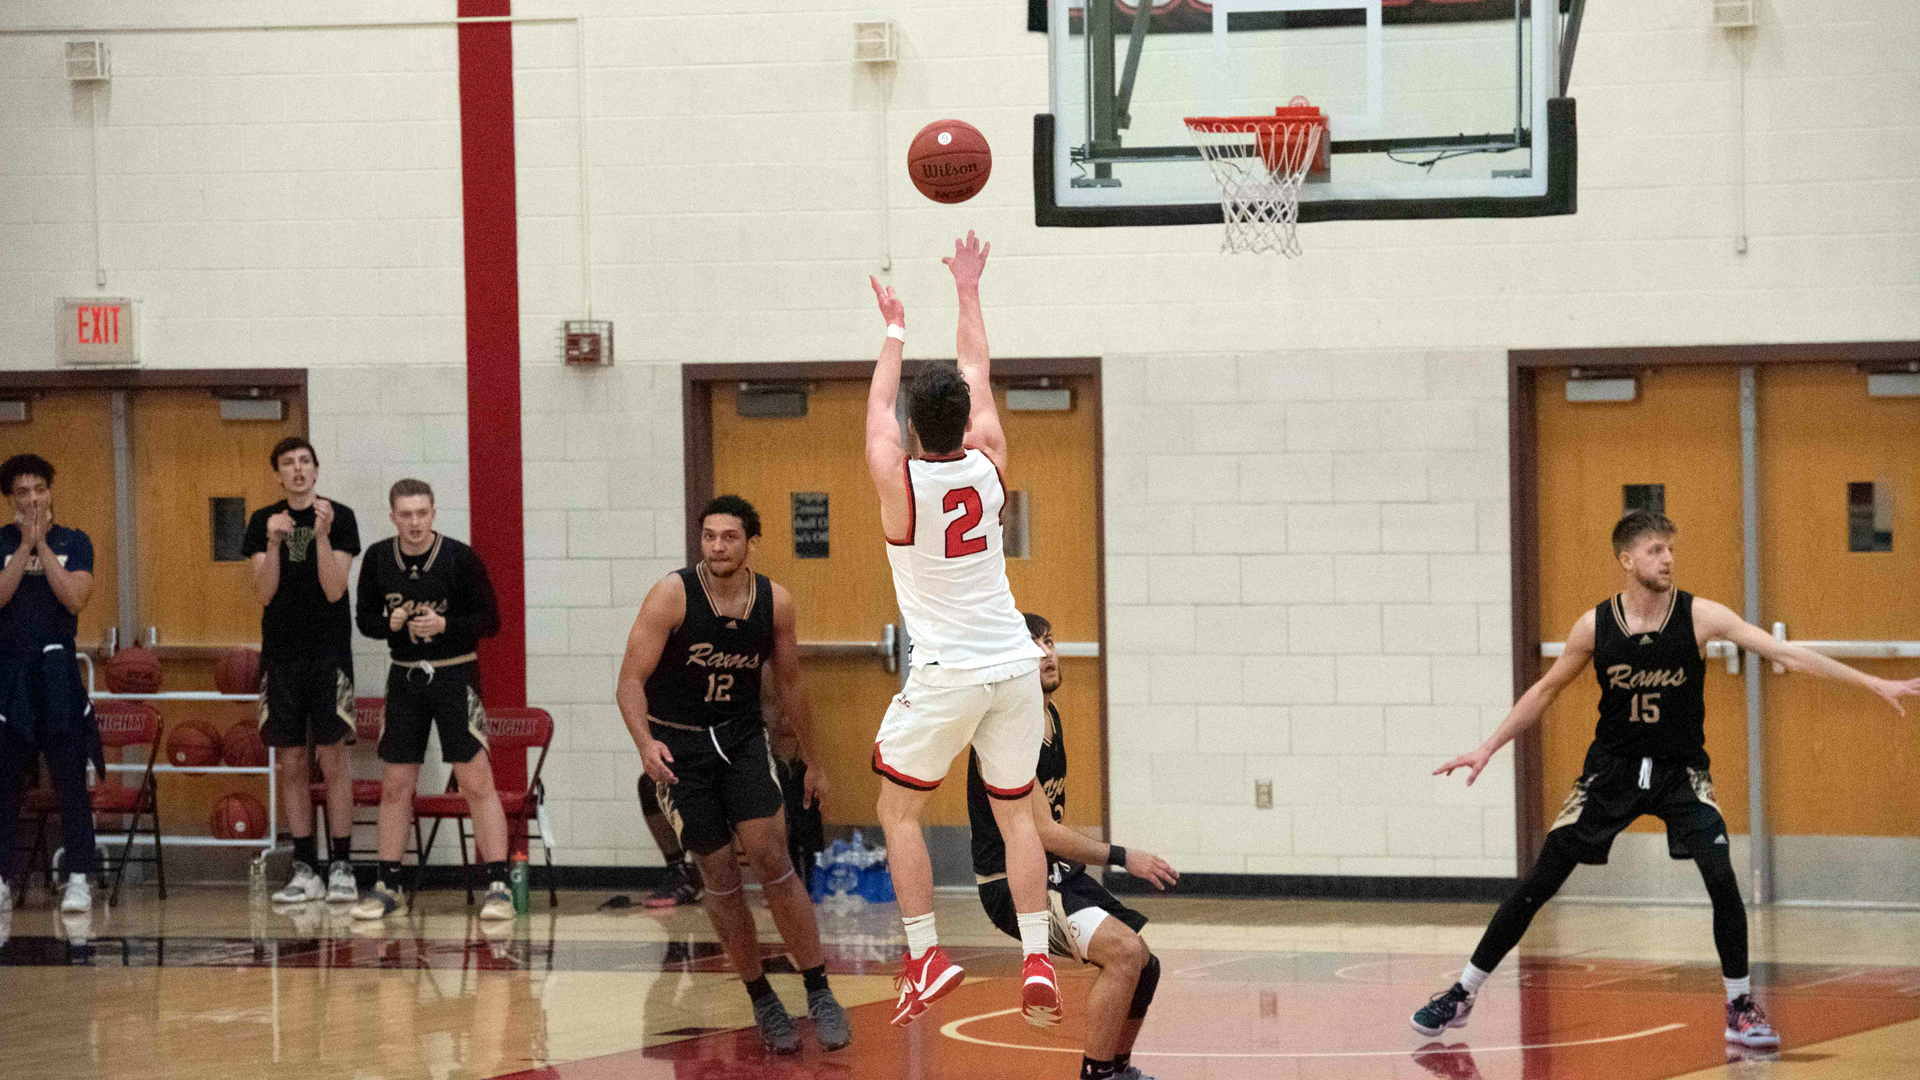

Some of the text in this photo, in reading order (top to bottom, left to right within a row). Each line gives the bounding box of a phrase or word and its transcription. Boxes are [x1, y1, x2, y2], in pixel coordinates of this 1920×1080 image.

[922, 162, 977, 179] Wilson
[78, 305, 120, 344] EXIT
[943, 486, 988, 559] 2
[686, 642, 760, 669] Rams
[704, 673, 734, 702] 12
[1607, 664, 1687, 690] Rams
[1629, 693, 1660, 723] 15
[95, 713, 148, 731] NIGHTS
[486, 717, 537, 736] NIGHTS
